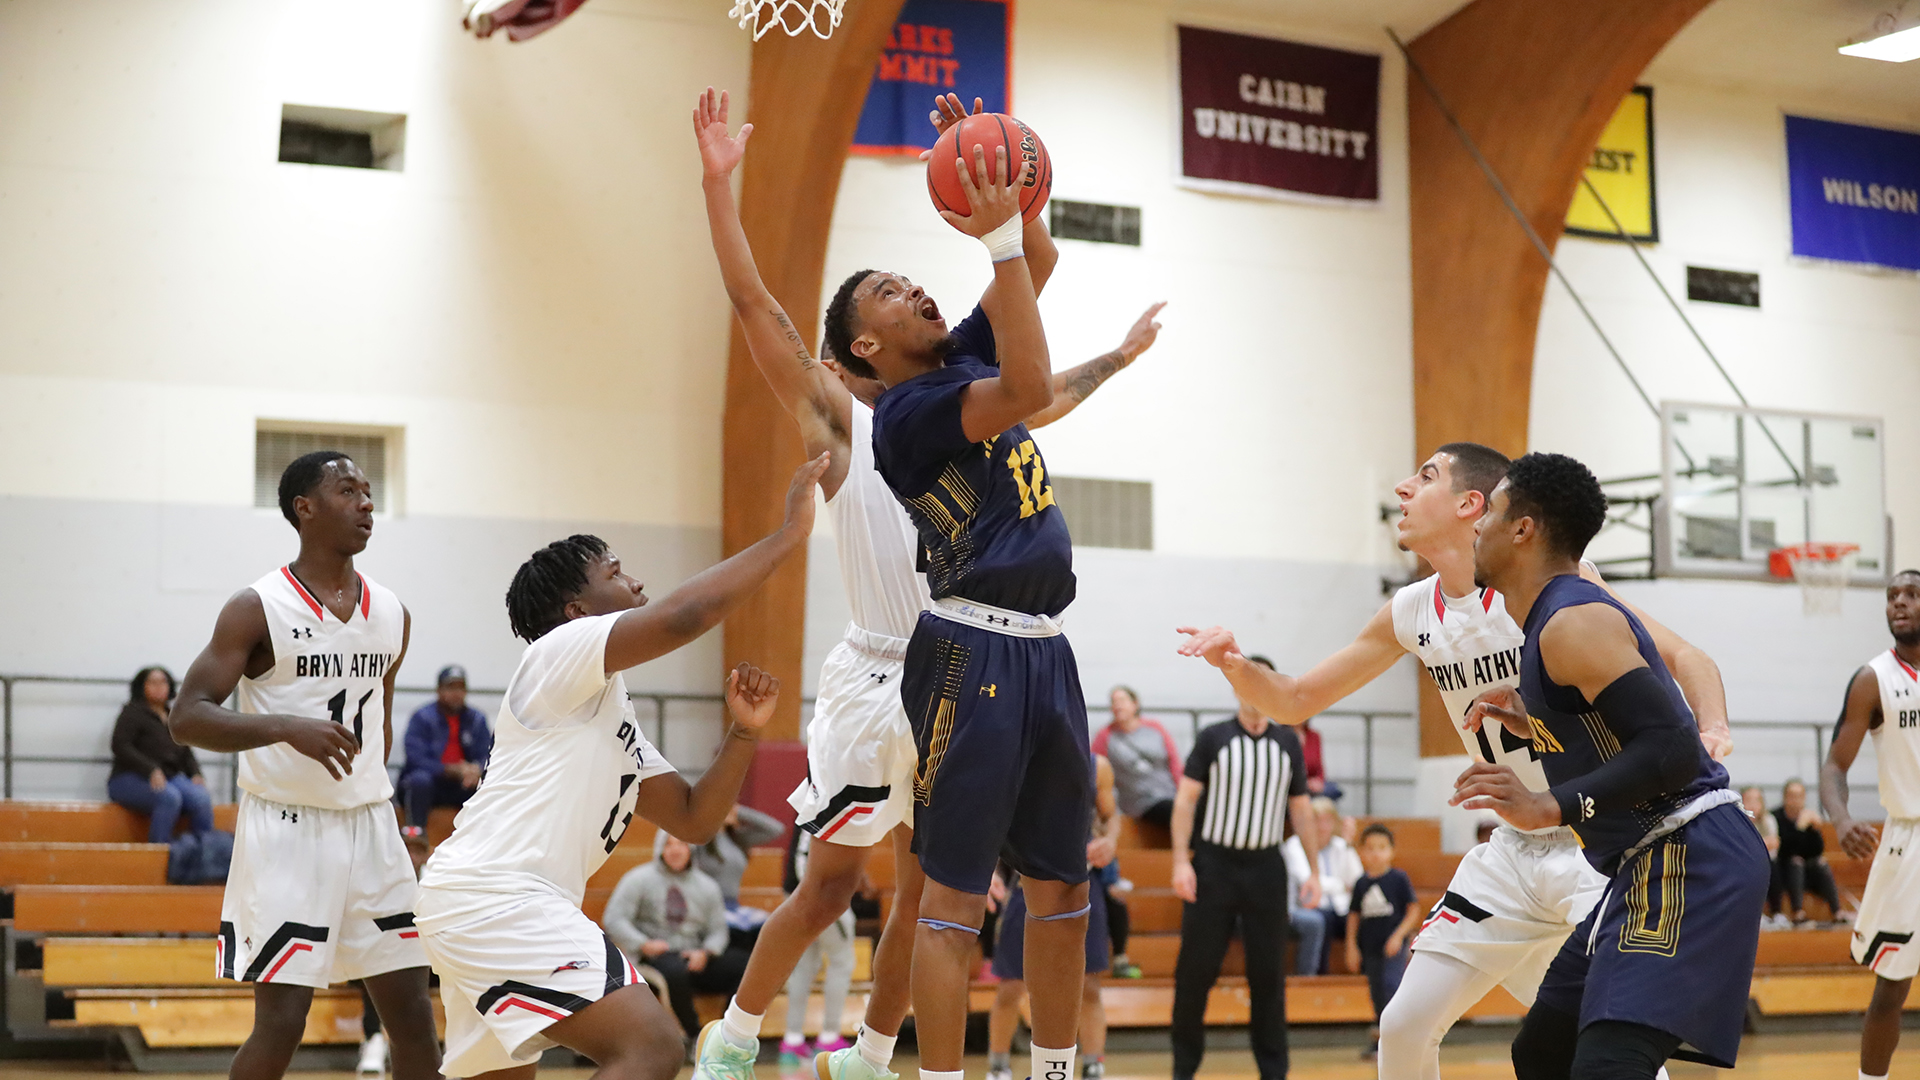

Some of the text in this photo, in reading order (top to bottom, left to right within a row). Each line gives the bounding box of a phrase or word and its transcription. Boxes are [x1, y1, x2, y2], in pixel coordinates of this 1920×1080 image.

[1238, 74, 1327, 114] CAIRN
[1193, 108, 1369, 160] UNIVERSITY
[1587, 148, 1636, 173] EST
[1822, 177, 1919, 213] WILSON
[1006, 439, 1056, 519] 12
[296, 653, 343, 677] BRYN
[328, 688, 374, 752] 11
[1899, 709, 1920, 729] BR
